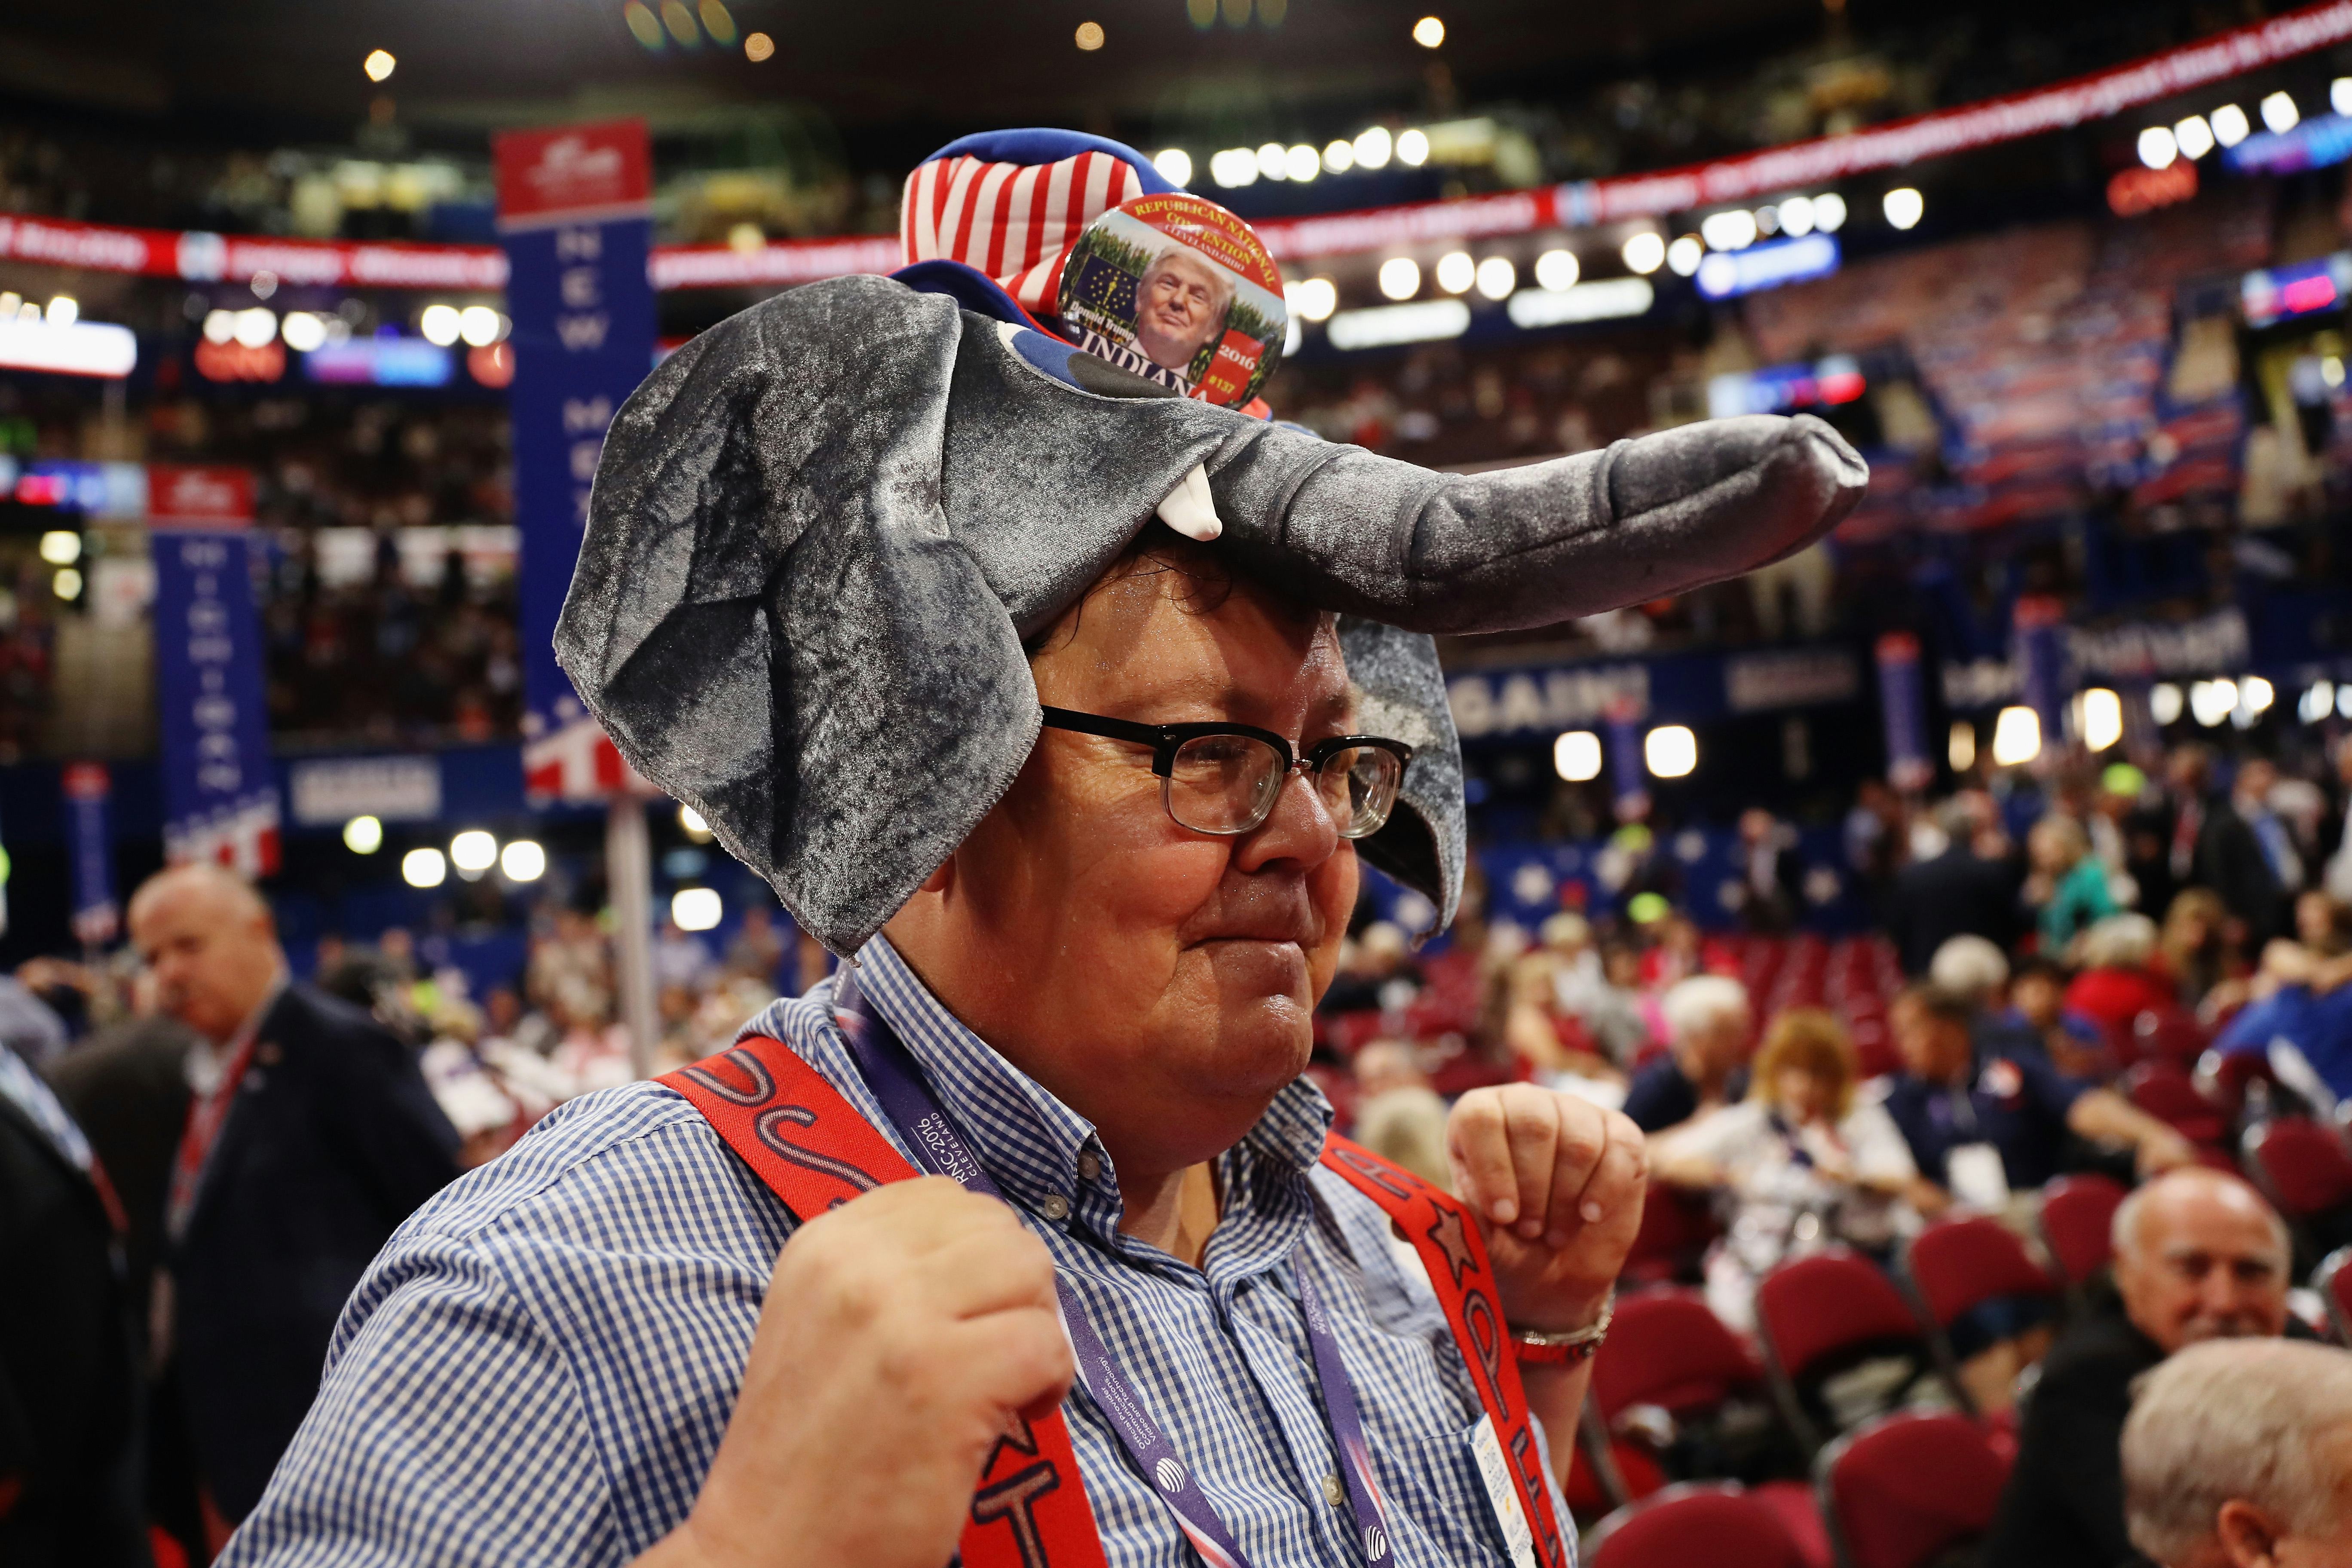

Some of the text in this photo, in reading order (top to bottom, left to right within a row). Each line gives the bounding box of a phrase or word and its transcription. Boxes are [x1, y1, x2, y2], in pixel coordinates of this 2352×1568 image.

[1135, 200, 1226, 226] REPUBLICAN
[1227, 220, 1275, 287] NATIONAL
[1167, 212, 1253, 265] COENTION
[1069, 300, 1135, 341] Donald Trump
[1218, 344, 1256, 371] 2016
[917, 1118, 969, 1184] RNC 2016
[931, 1112, 977, 1176] CLEVELAND
[1098, 1357, 1156, 1442] Video and Technology
[1101, 1387, 1145, 1449] Official Provider
[1105, 1376, 1151, 1445] Communications,
